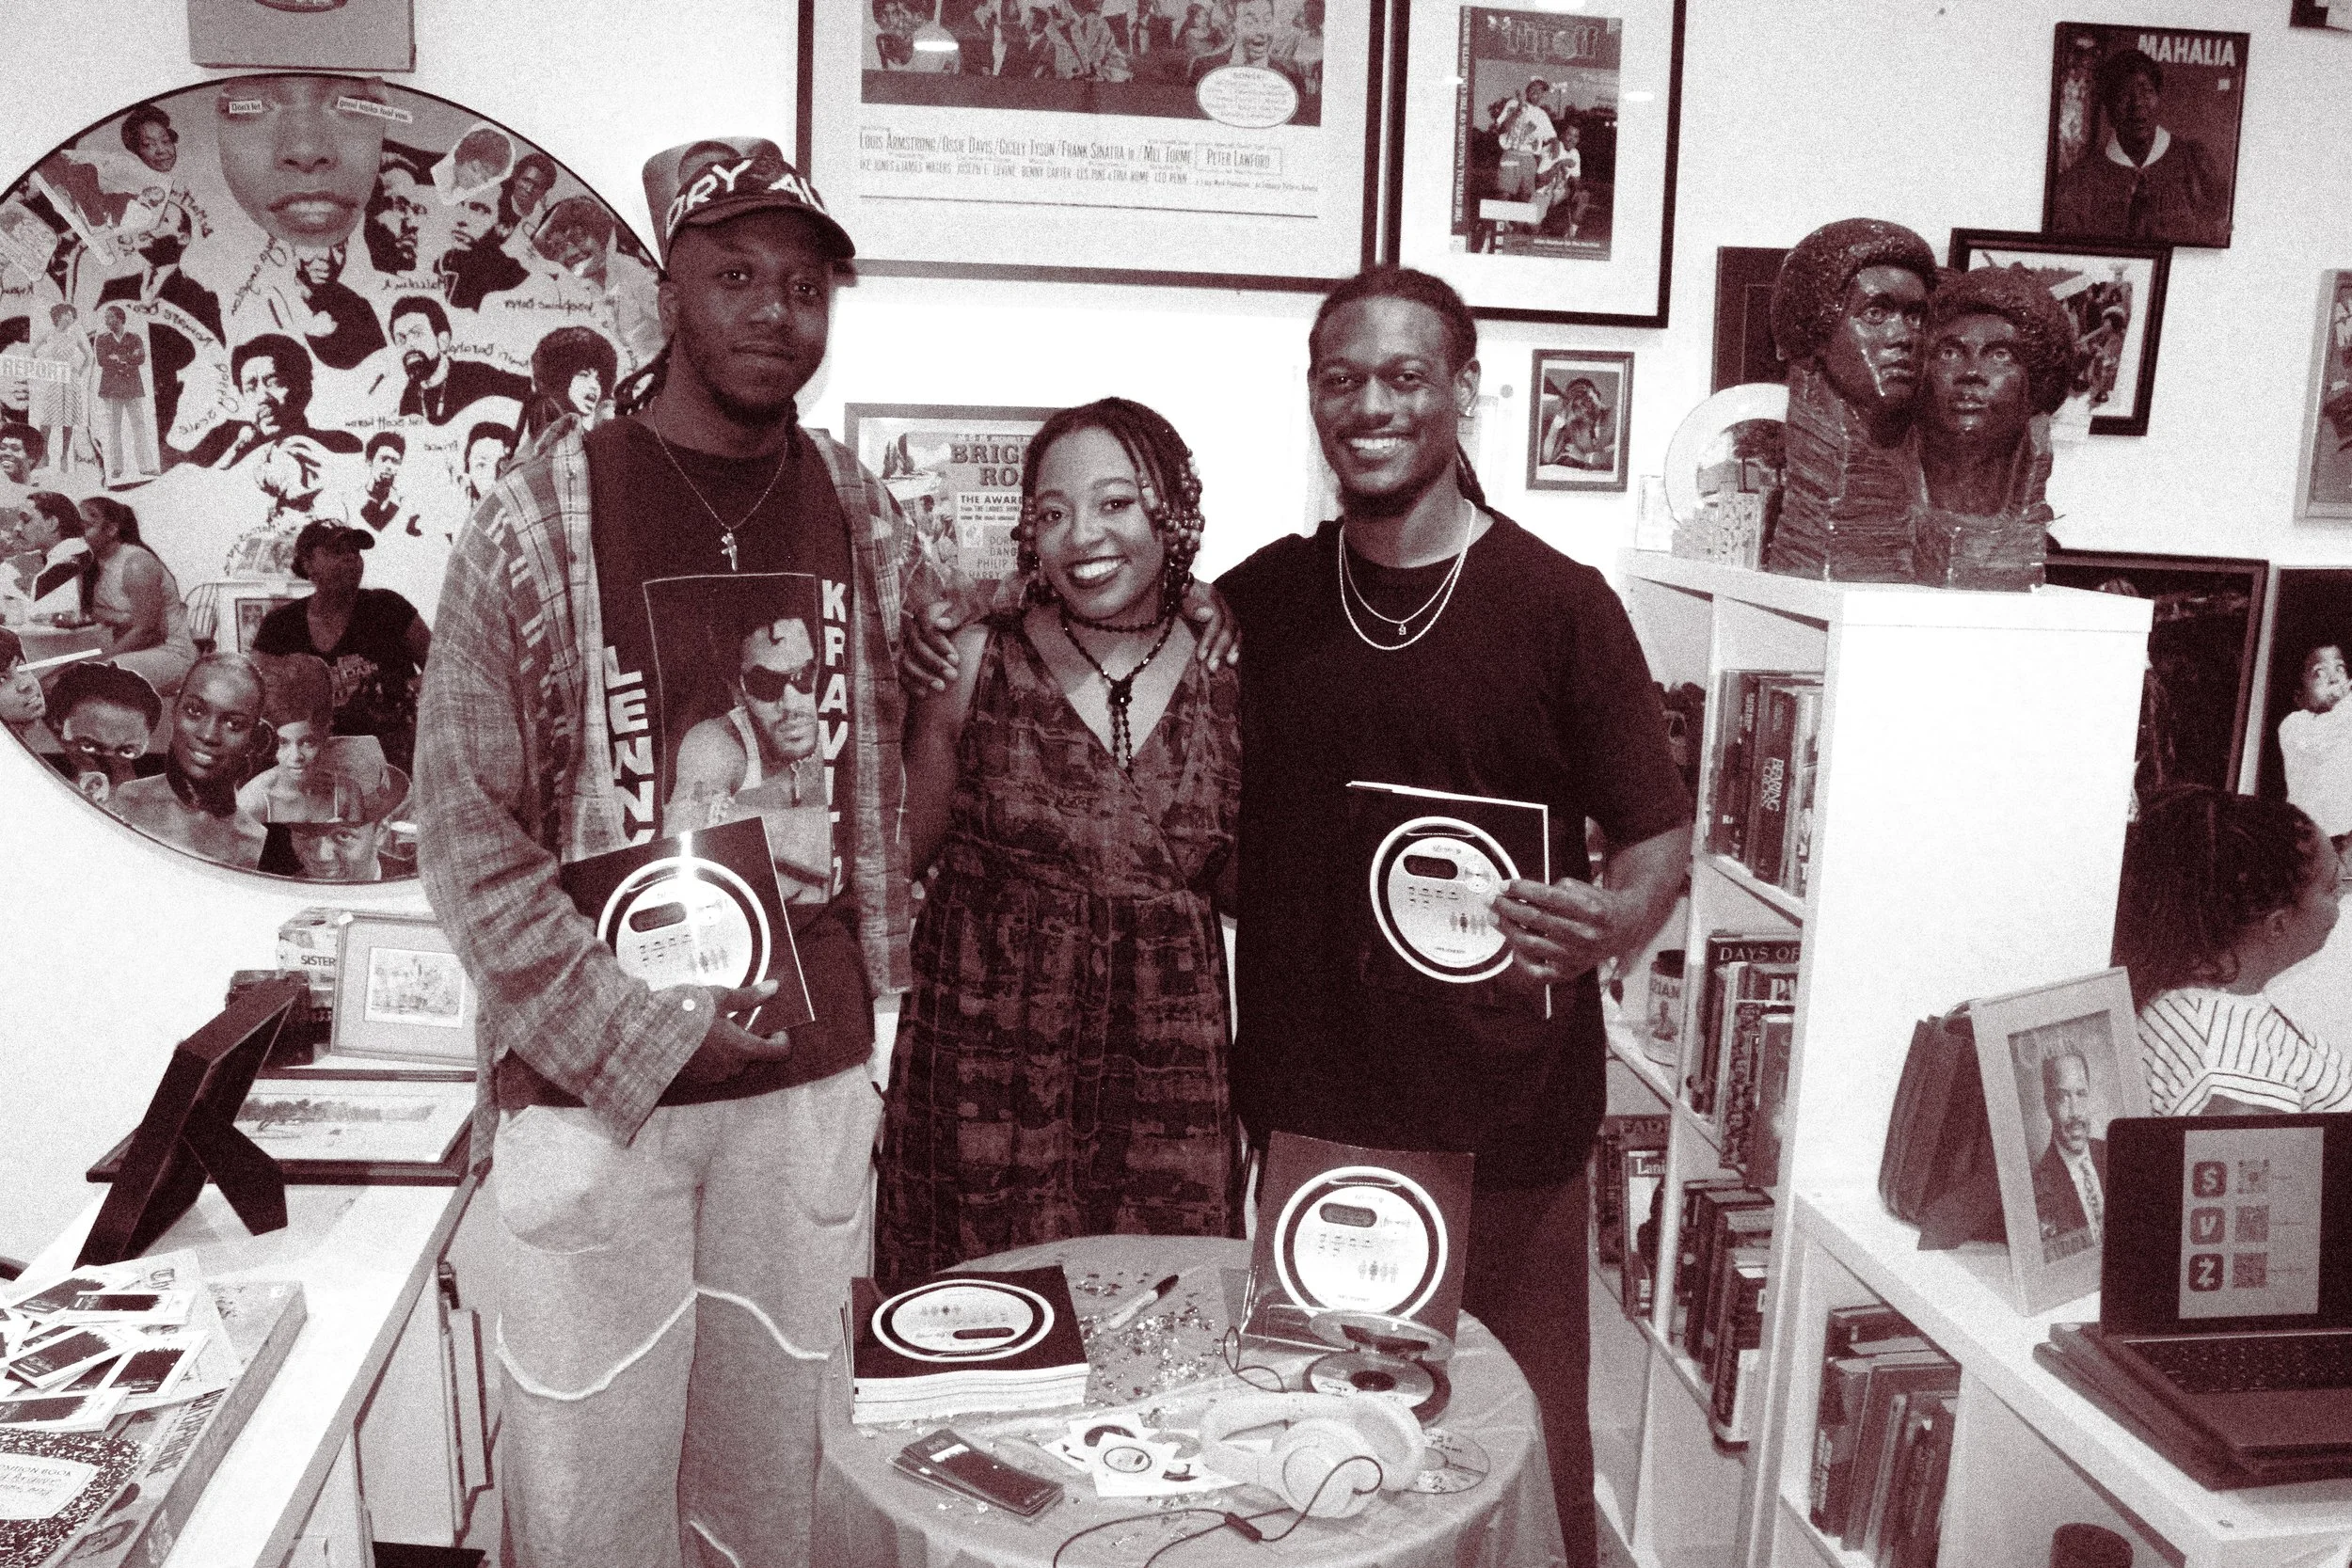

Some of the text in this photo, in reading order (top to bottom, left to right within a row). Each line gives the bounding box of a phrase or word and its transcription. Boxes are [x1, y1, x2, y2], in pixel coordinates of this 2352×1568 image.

[2137, 34, 2235, 67] MAHALIA
[949, 444, 1026, 465] BRIG
[979, 467, 1021, 487] RO
[961, 495, 980, 504] THE
[818, 579, 848, 896] KRAVITZ
[1720, 945, 1769, 960] DAYS
